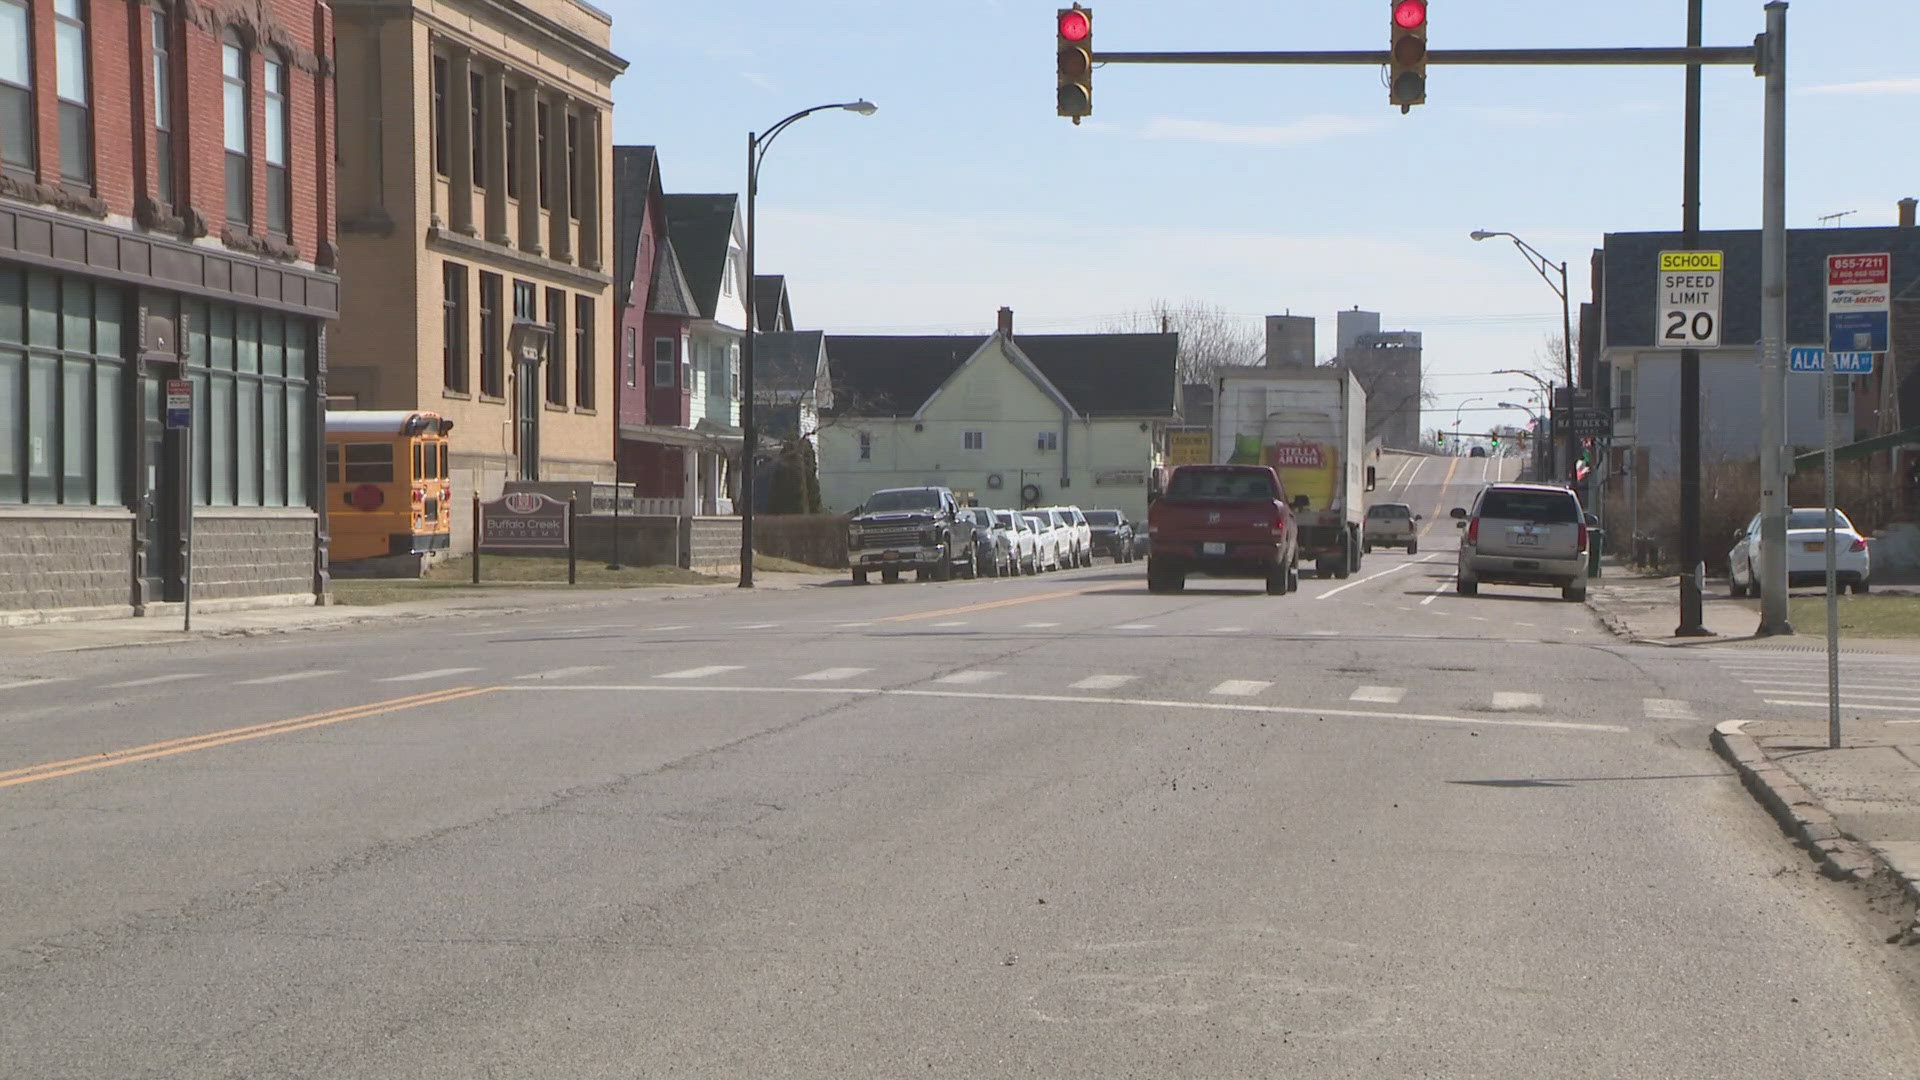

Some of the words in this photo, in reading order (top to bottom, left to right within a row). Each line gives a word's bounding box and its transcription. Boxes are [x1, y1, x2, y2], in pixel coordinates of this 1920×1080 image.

[1663, 255, 1718, 267] SCHOOL
[1834, 258, 1883, 269] 855-7211
[1665, 276, 1714, 288] SPEED
[1670, 292, 1709, 304] LIMIT
[1832, 296, 1885, 304] NFTA-METRO
[1665, 311, 1713, 340] 20
[1557, 419, 1609, 428] MAUREK'S
[1279, 447, 1318, 456] STELLA
[1278, 456, 1318, 464] ARTOIS
[487, 519, 525, 529] Buffalo
[527, 519, 561, 529] Creek
